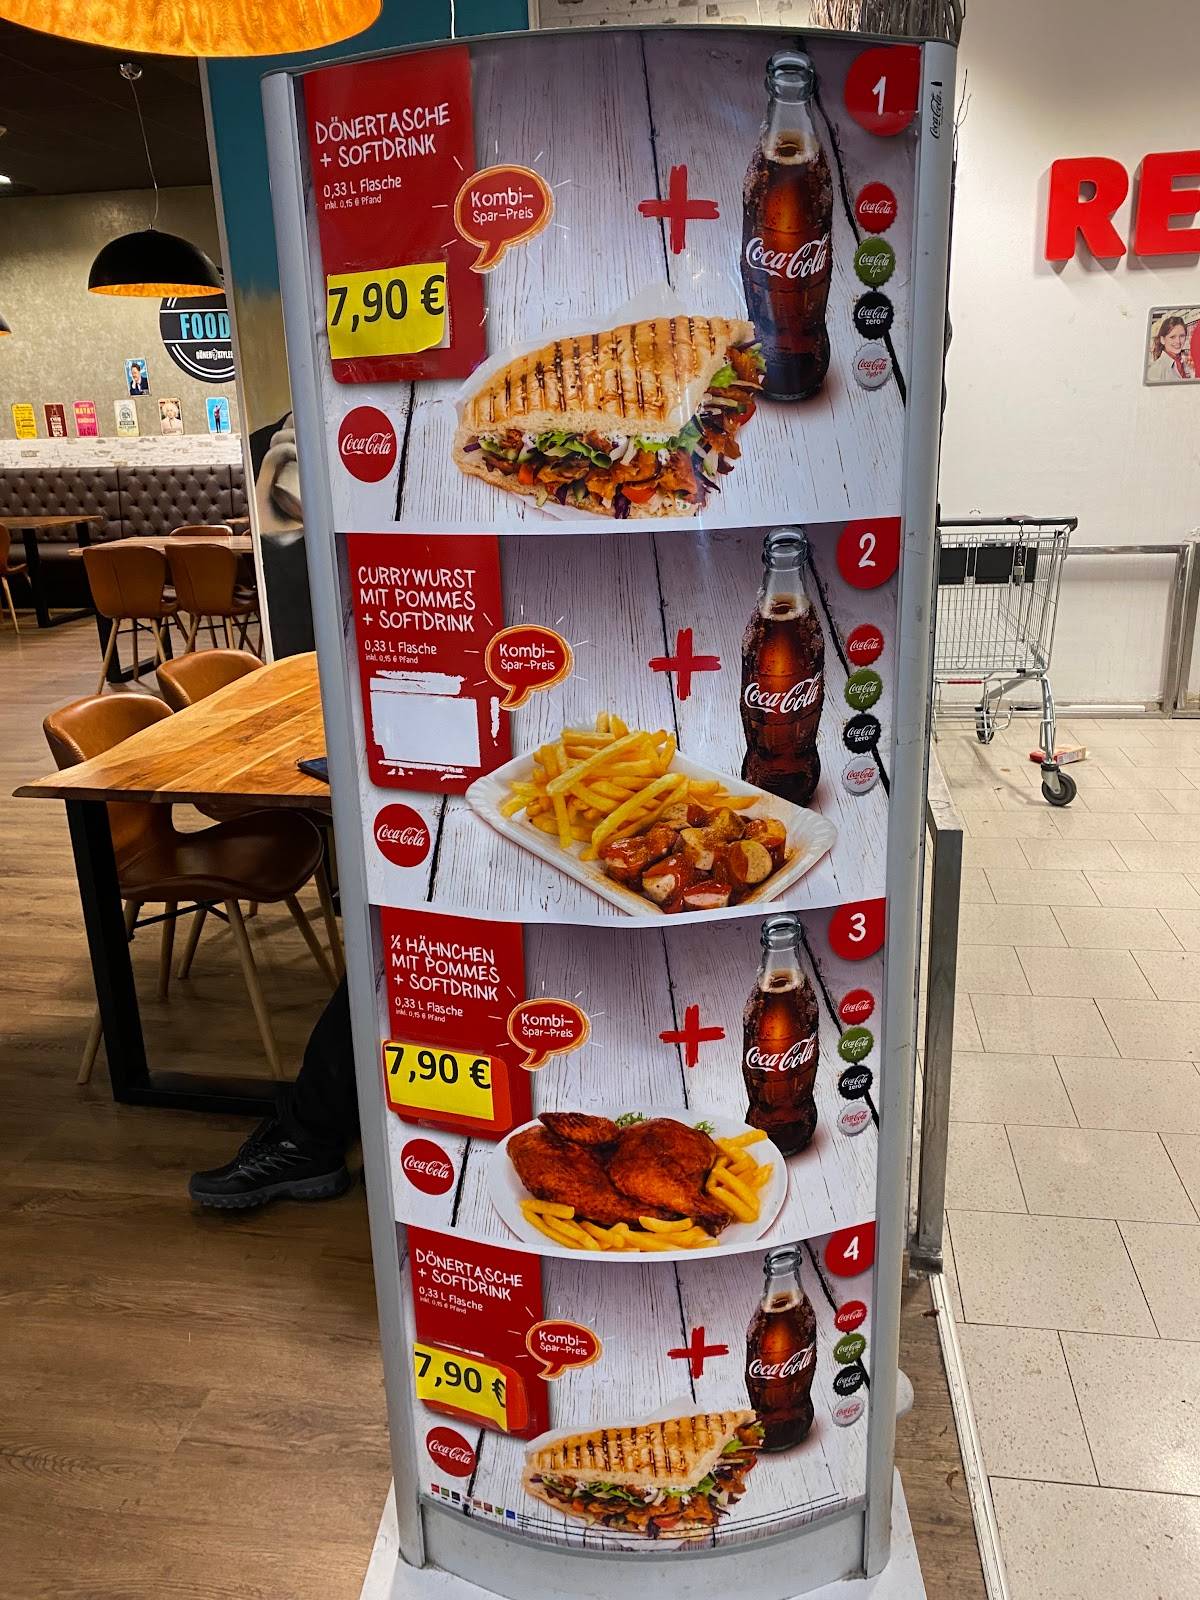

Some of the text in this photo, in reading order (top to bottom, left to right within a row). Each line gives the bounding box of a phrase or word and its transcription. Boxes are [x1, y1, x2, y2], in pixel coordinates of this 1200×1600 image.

[872, 76, 886, 115] 1
[315, 103, 450, 144] DÖNERTASCHE
[320, 134, 437, 168] + SOFTDRINK
[324, 174, 402, 198] 0,33 L Flasche
[471, 187, 534, 207] Kombi-
[362, 194, 382, 205] Pfand
[860, 200, 892, 214] Coca-Cola
[472, 208, 534, 226] Spar-Preis
[746, 232, 829, 280] Coca-Cola
[328, 274, 444, 332] 7,90 €
[180, 312, 231, 339] FOOD
[342, 433, 392, 456] Coca-Cola
[858, 533, 876, 568] 2
[358, 566, 476, 588] CURRYWURST
[360, 588, 476, 611] MIT POMMES
[362, 610, 474, 632] + SOFTDRINK
[364, 640, 437, 654] 0,33 L Flasche
[500, 644, 555, 658] Kombi-
[399, 656, 418, 664] Pfand
[501, 660, 556, 671] Spar-Preis
[744, 672, 822, 714] Coca-Cola
[377, 824, 426, 847] Coca-Cola
[848, 912, 866, 942] 3
[406, 936, 494, 964] HÄHNCHEN
[392, 954, 500, 984] MIT POMMES
[394, 974, 499, 1002] + SOFTDRINK
[395, 996, 464, 1016] 0,33 L Flasche
[428, 1014, 446, 1022] Pfand
[522, 1014, 574, 1028] Kombi-
[522, 1027, 574, 1038] Spar-Preis
[746, 1032, 816, 1072] Coca-Cola
[385, 1046, 491, 1090] 7,90 €
[404, 1155, 452, 1179] Coca-Cola
[844, 1236, 858, 1260] 4
[416, 1248, 523, 1287] DÖNERTASCHE
[418, 1268, 512, 1302] + SOFTDRINK
[419, 1286, 482, 1312] 0,33 L Flasche
[539, 1330, 588, 1346] Kombi-
[540, 1342, 588, 1356] Spar-Preis
[750, 1341, 814, 1380] Coca-Cola
[414, 1352, 506, 1408] 7,90 €
[428, 1440, 472, 1466] Coca-Cola
